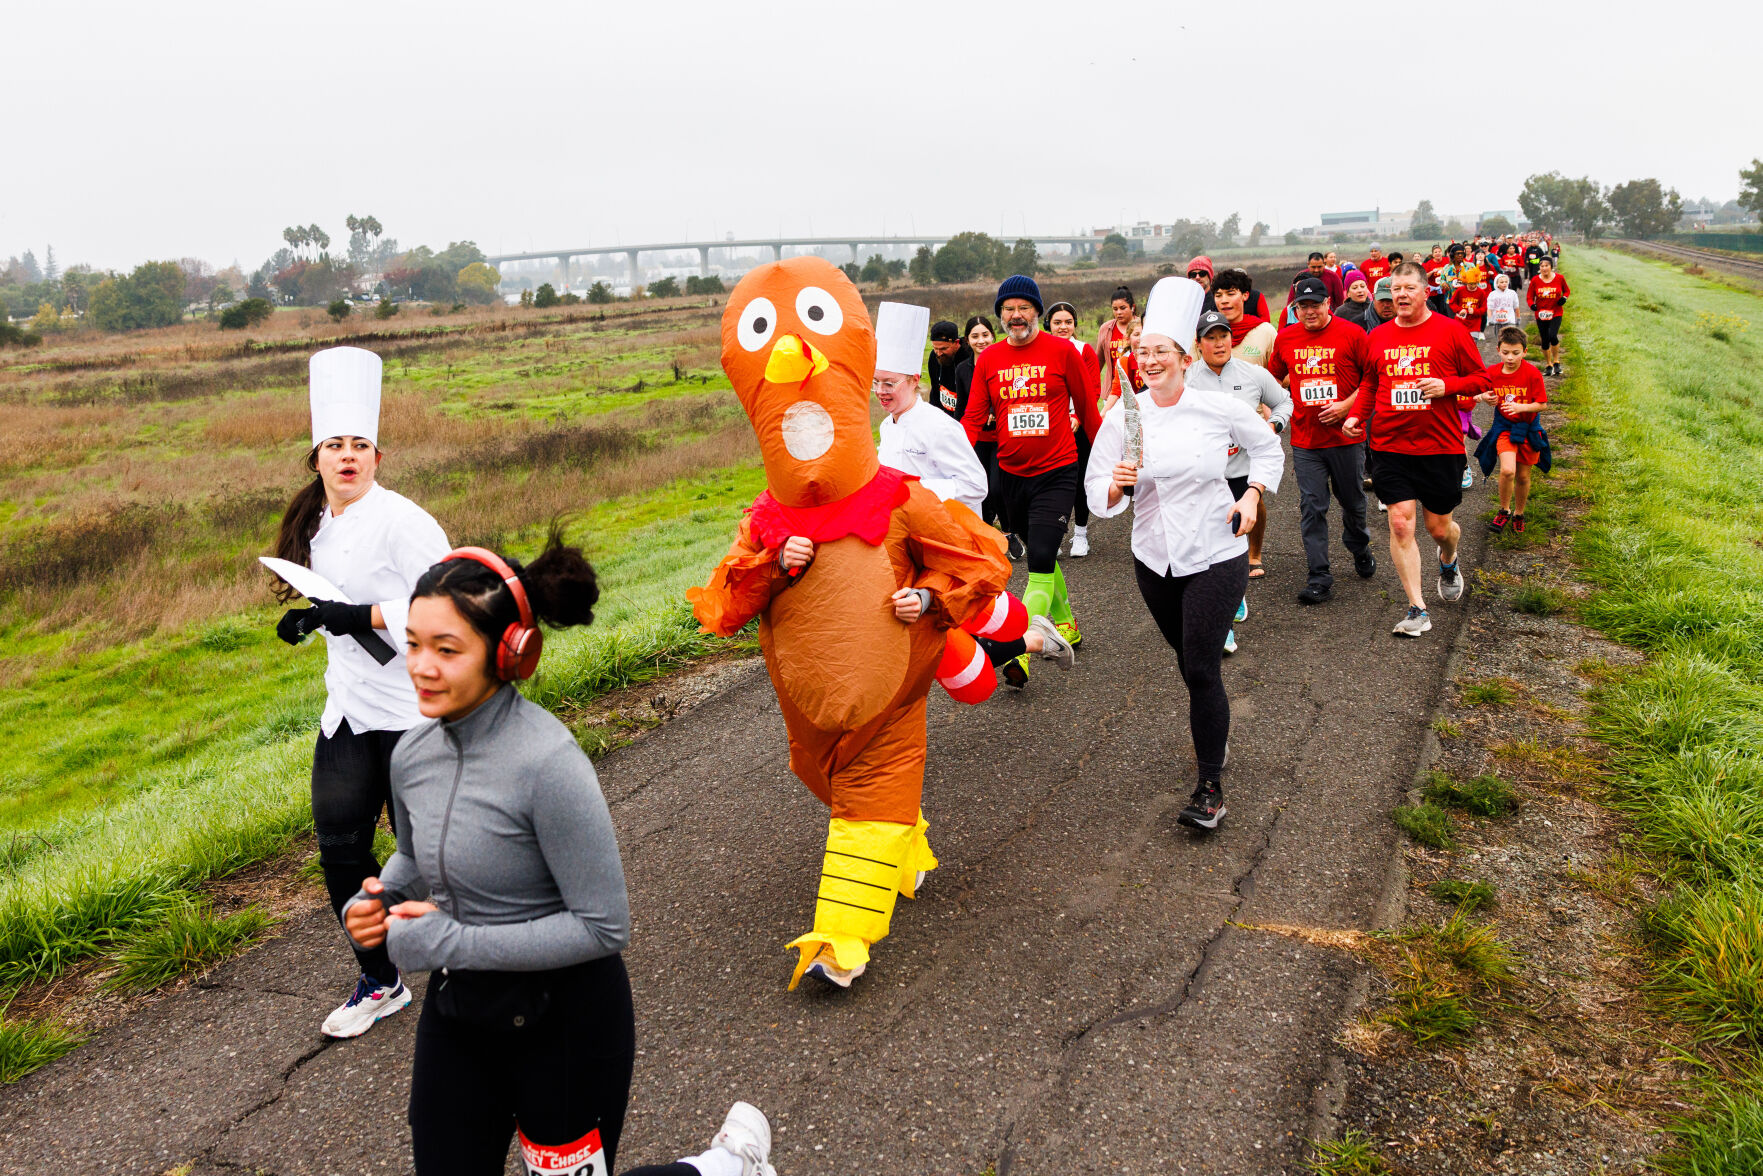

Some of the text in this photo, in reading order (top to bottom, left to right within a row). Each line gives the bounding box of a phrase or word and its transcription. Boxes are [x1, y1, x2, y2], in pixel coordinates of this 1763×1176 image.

[1294, 348, 1336, 359] TURKEY
[1384, 346, 1431, 360] TURKEY
[997, 365, 1047, 382] TURKEY
[1294, 363, 1336, 374] CHASE
[1386, 363, 1430, 376] CHASE
[999, 383, 1047, 399] CHASE
[1305, 386, 1333, 400] 0114
[1396, 390, 1425, 404] 0104
[1494, 387, 1527, 397] TURKEY
[1012, 413, 1045, 429] 1562
[550, 1144, 591, 1168] CHASE
